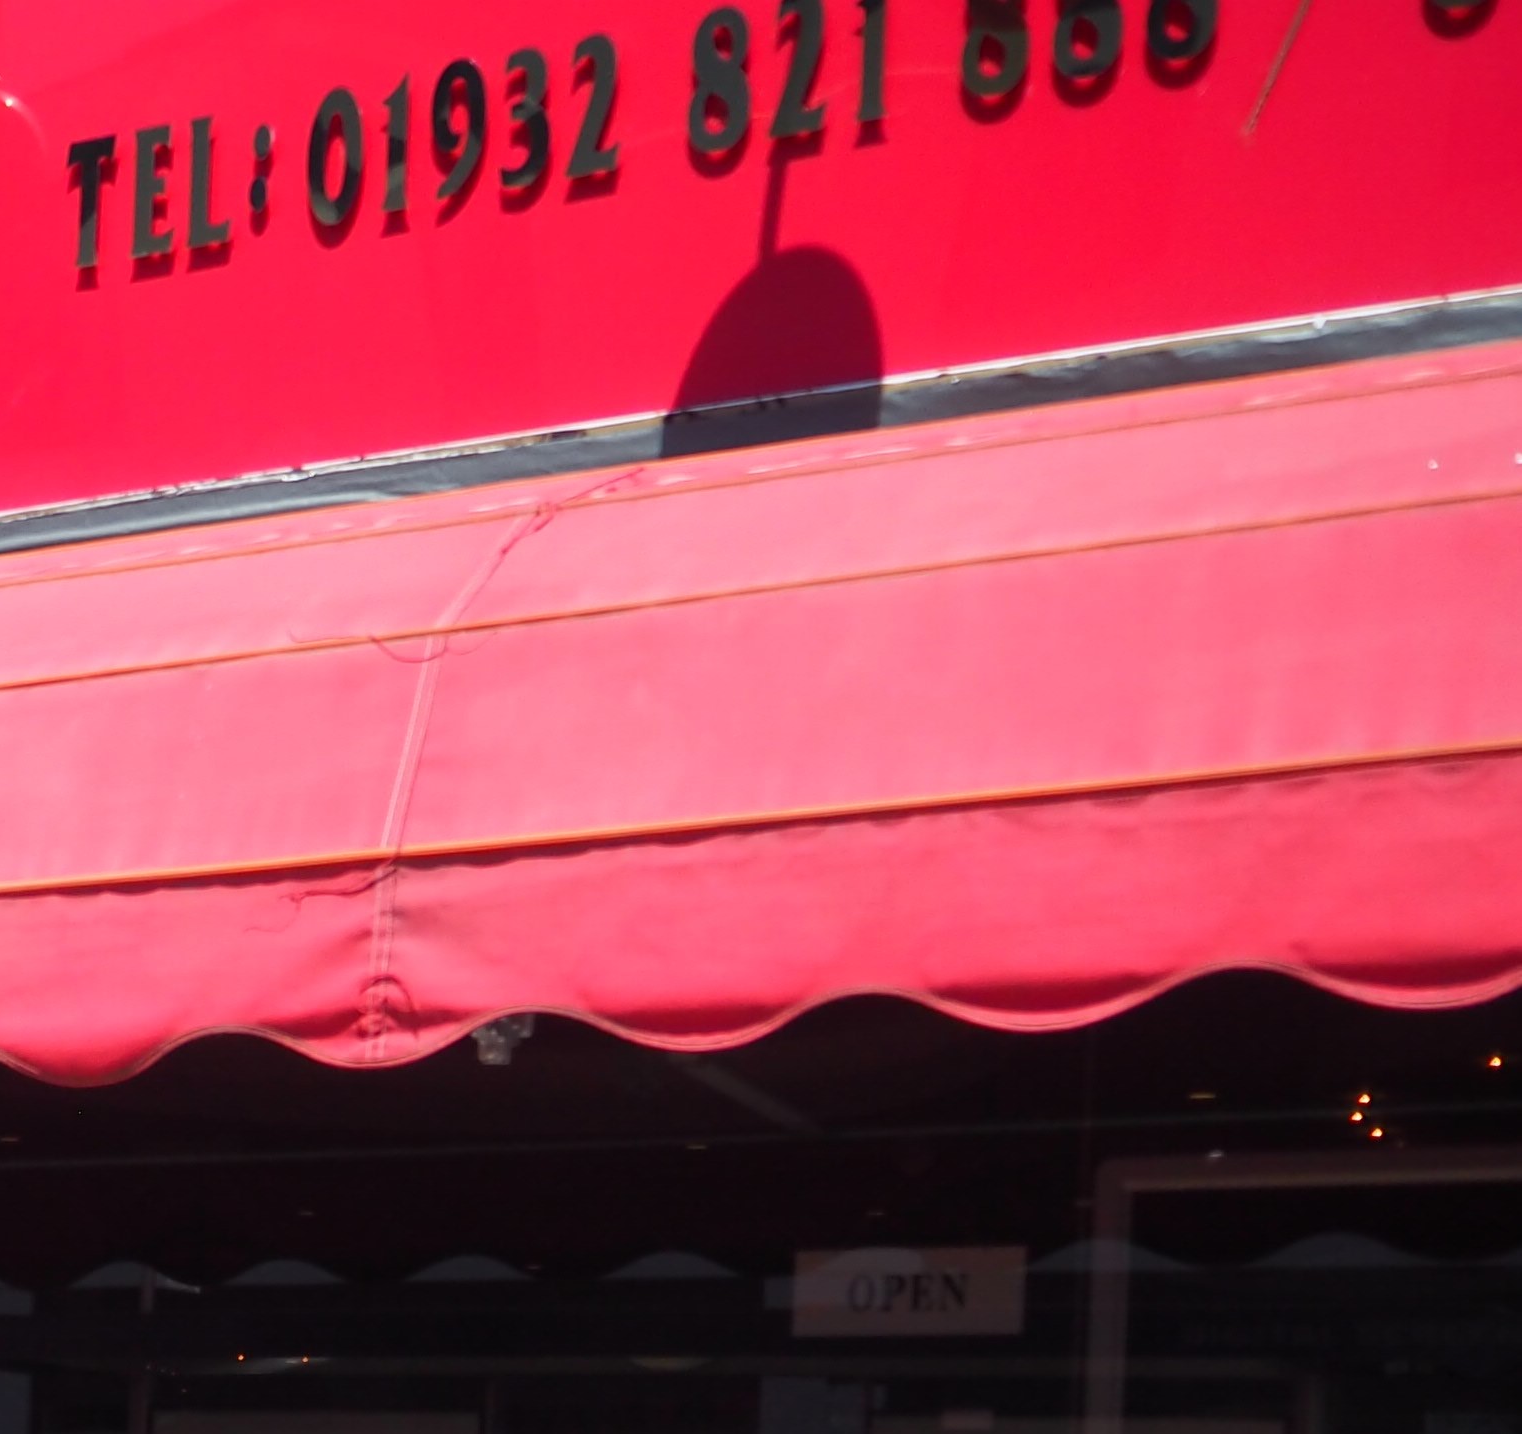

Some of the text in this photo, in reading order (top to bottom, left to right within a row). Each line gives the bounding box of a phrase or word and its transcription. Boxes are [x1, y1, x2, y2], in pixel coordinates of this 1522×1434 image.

[307, 32, 621, 227] 01932
[689, 0, 885, 152] 821
[847, 1272, 968, 1312] OPEN
